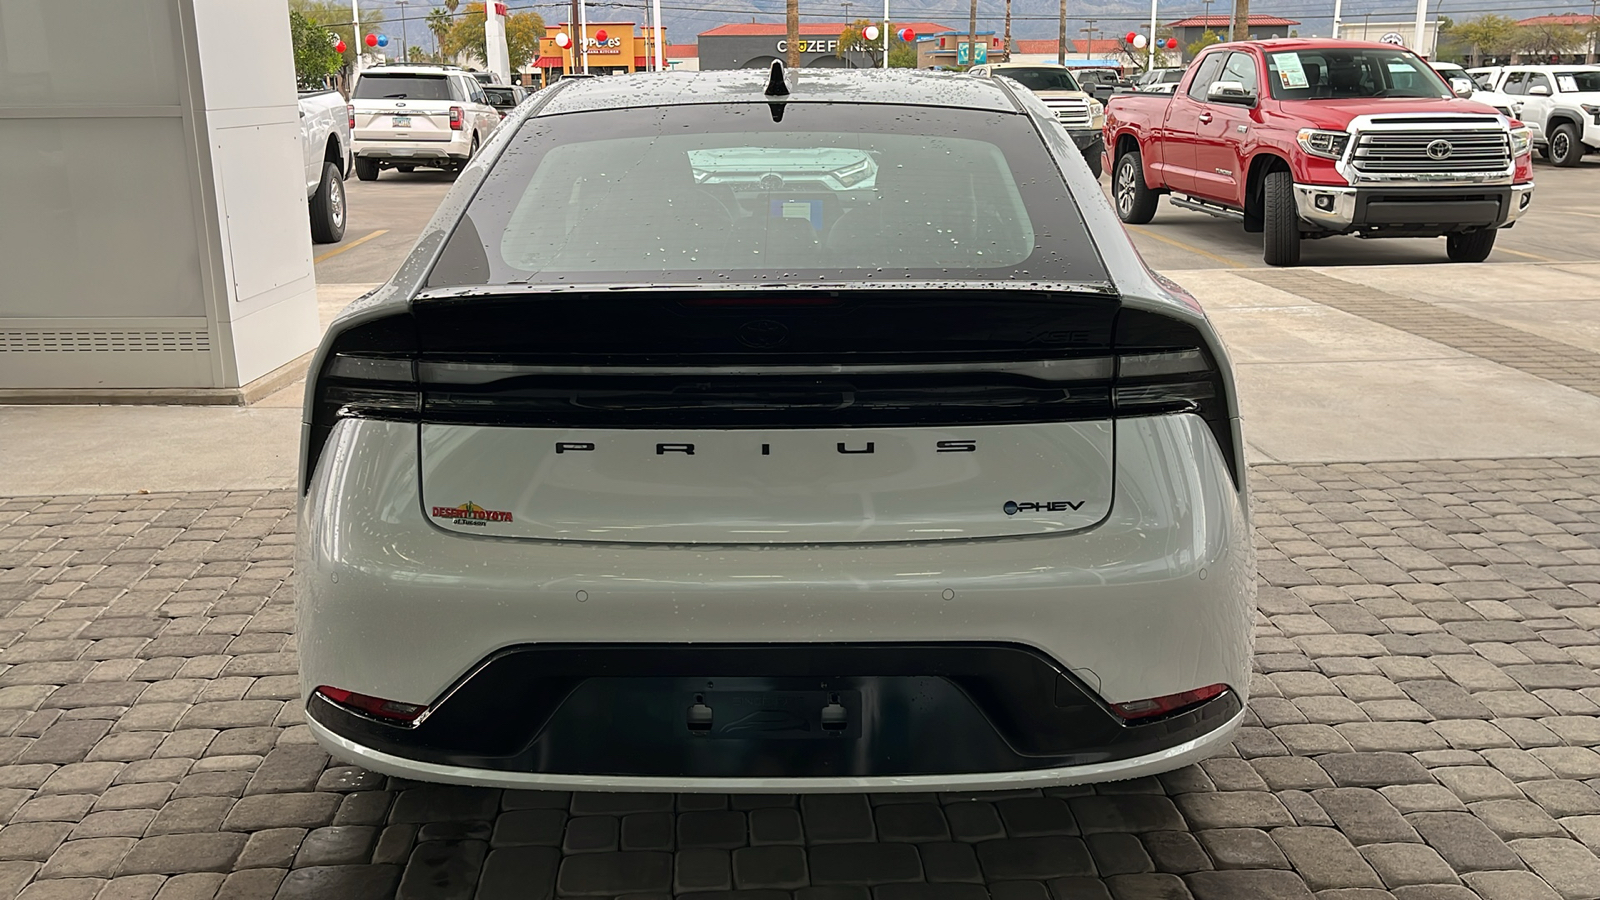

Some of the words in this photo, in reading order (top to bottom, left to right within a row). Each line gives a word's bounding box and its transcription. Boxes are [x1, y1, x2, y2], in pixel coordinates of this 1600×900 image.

[776, 39, 826, 53] CUZE
[555, 440, 977, 456] PRIUS
[1018, 500, 1085, 512] PHEV
[432, 506, 468, 518] DESERT
[472, 510, 514, 522] TOYOTA
